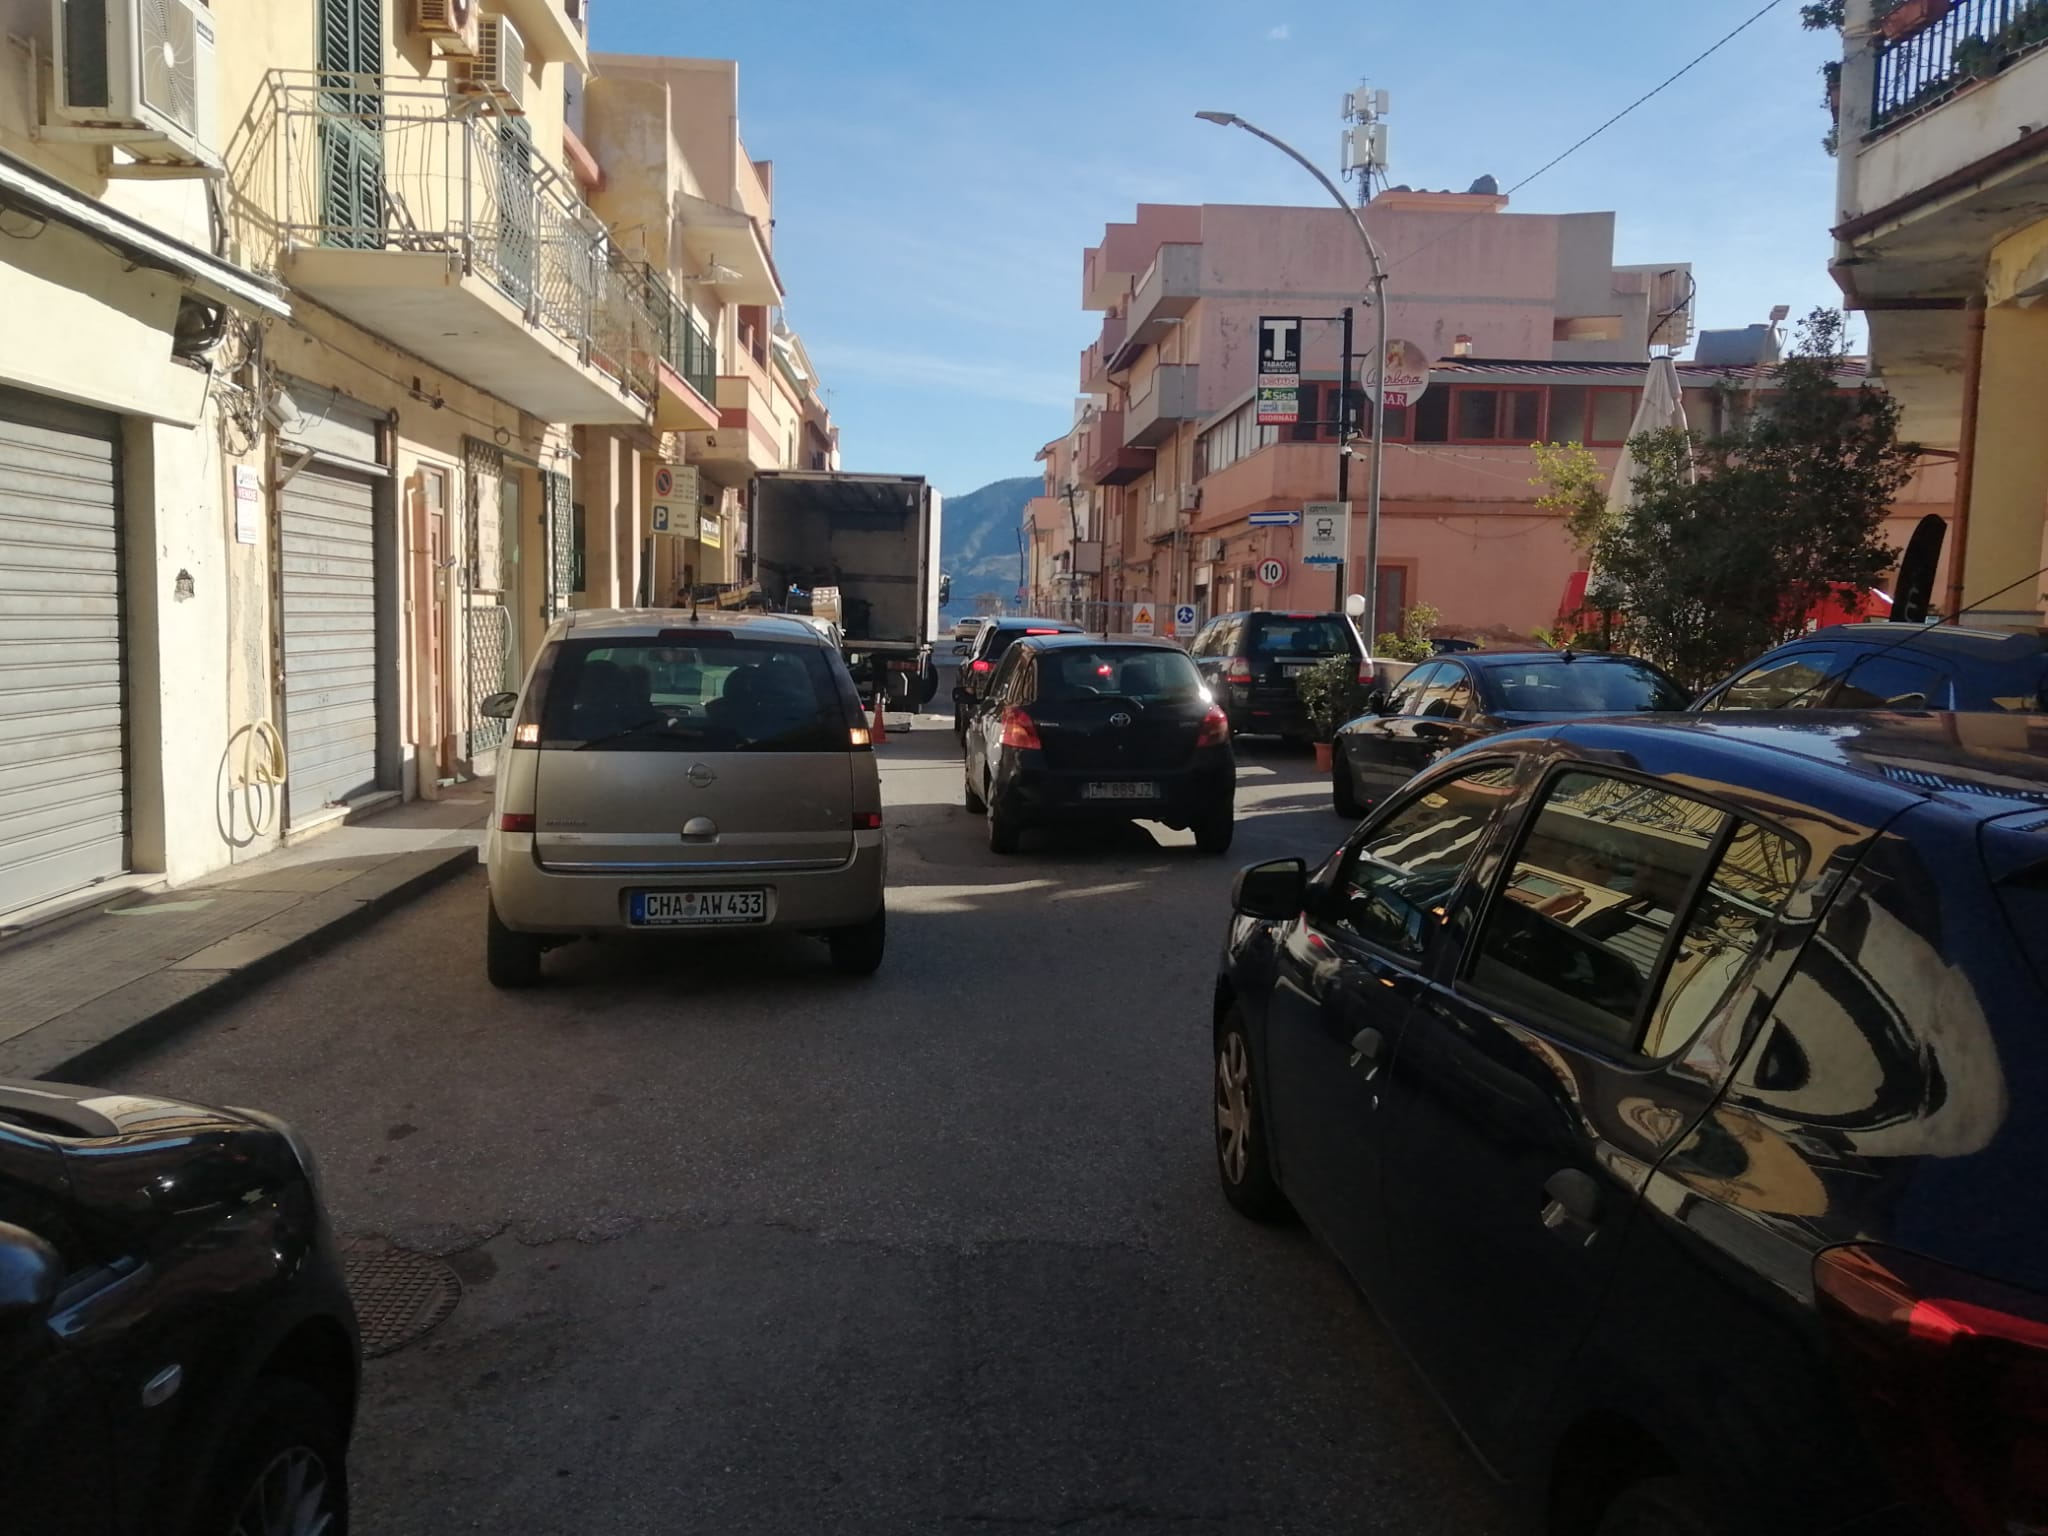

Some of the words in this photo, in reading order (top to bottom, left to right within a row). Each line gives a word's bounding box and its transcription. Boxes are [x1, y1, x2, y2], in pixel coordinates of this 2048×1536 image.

[1263, 320, 1297, 360] T
[1273, 391, 1296, 400] Sisal
[1259, 414, 1297, 422] GIORNALI
[655, 508, 667, 529] P
[1264, 564, 1278, 580] 10
[646, 895, 683, 916] CHA
[699, 894, 723, 916] AW
[727, 893, 762, 915] 433
